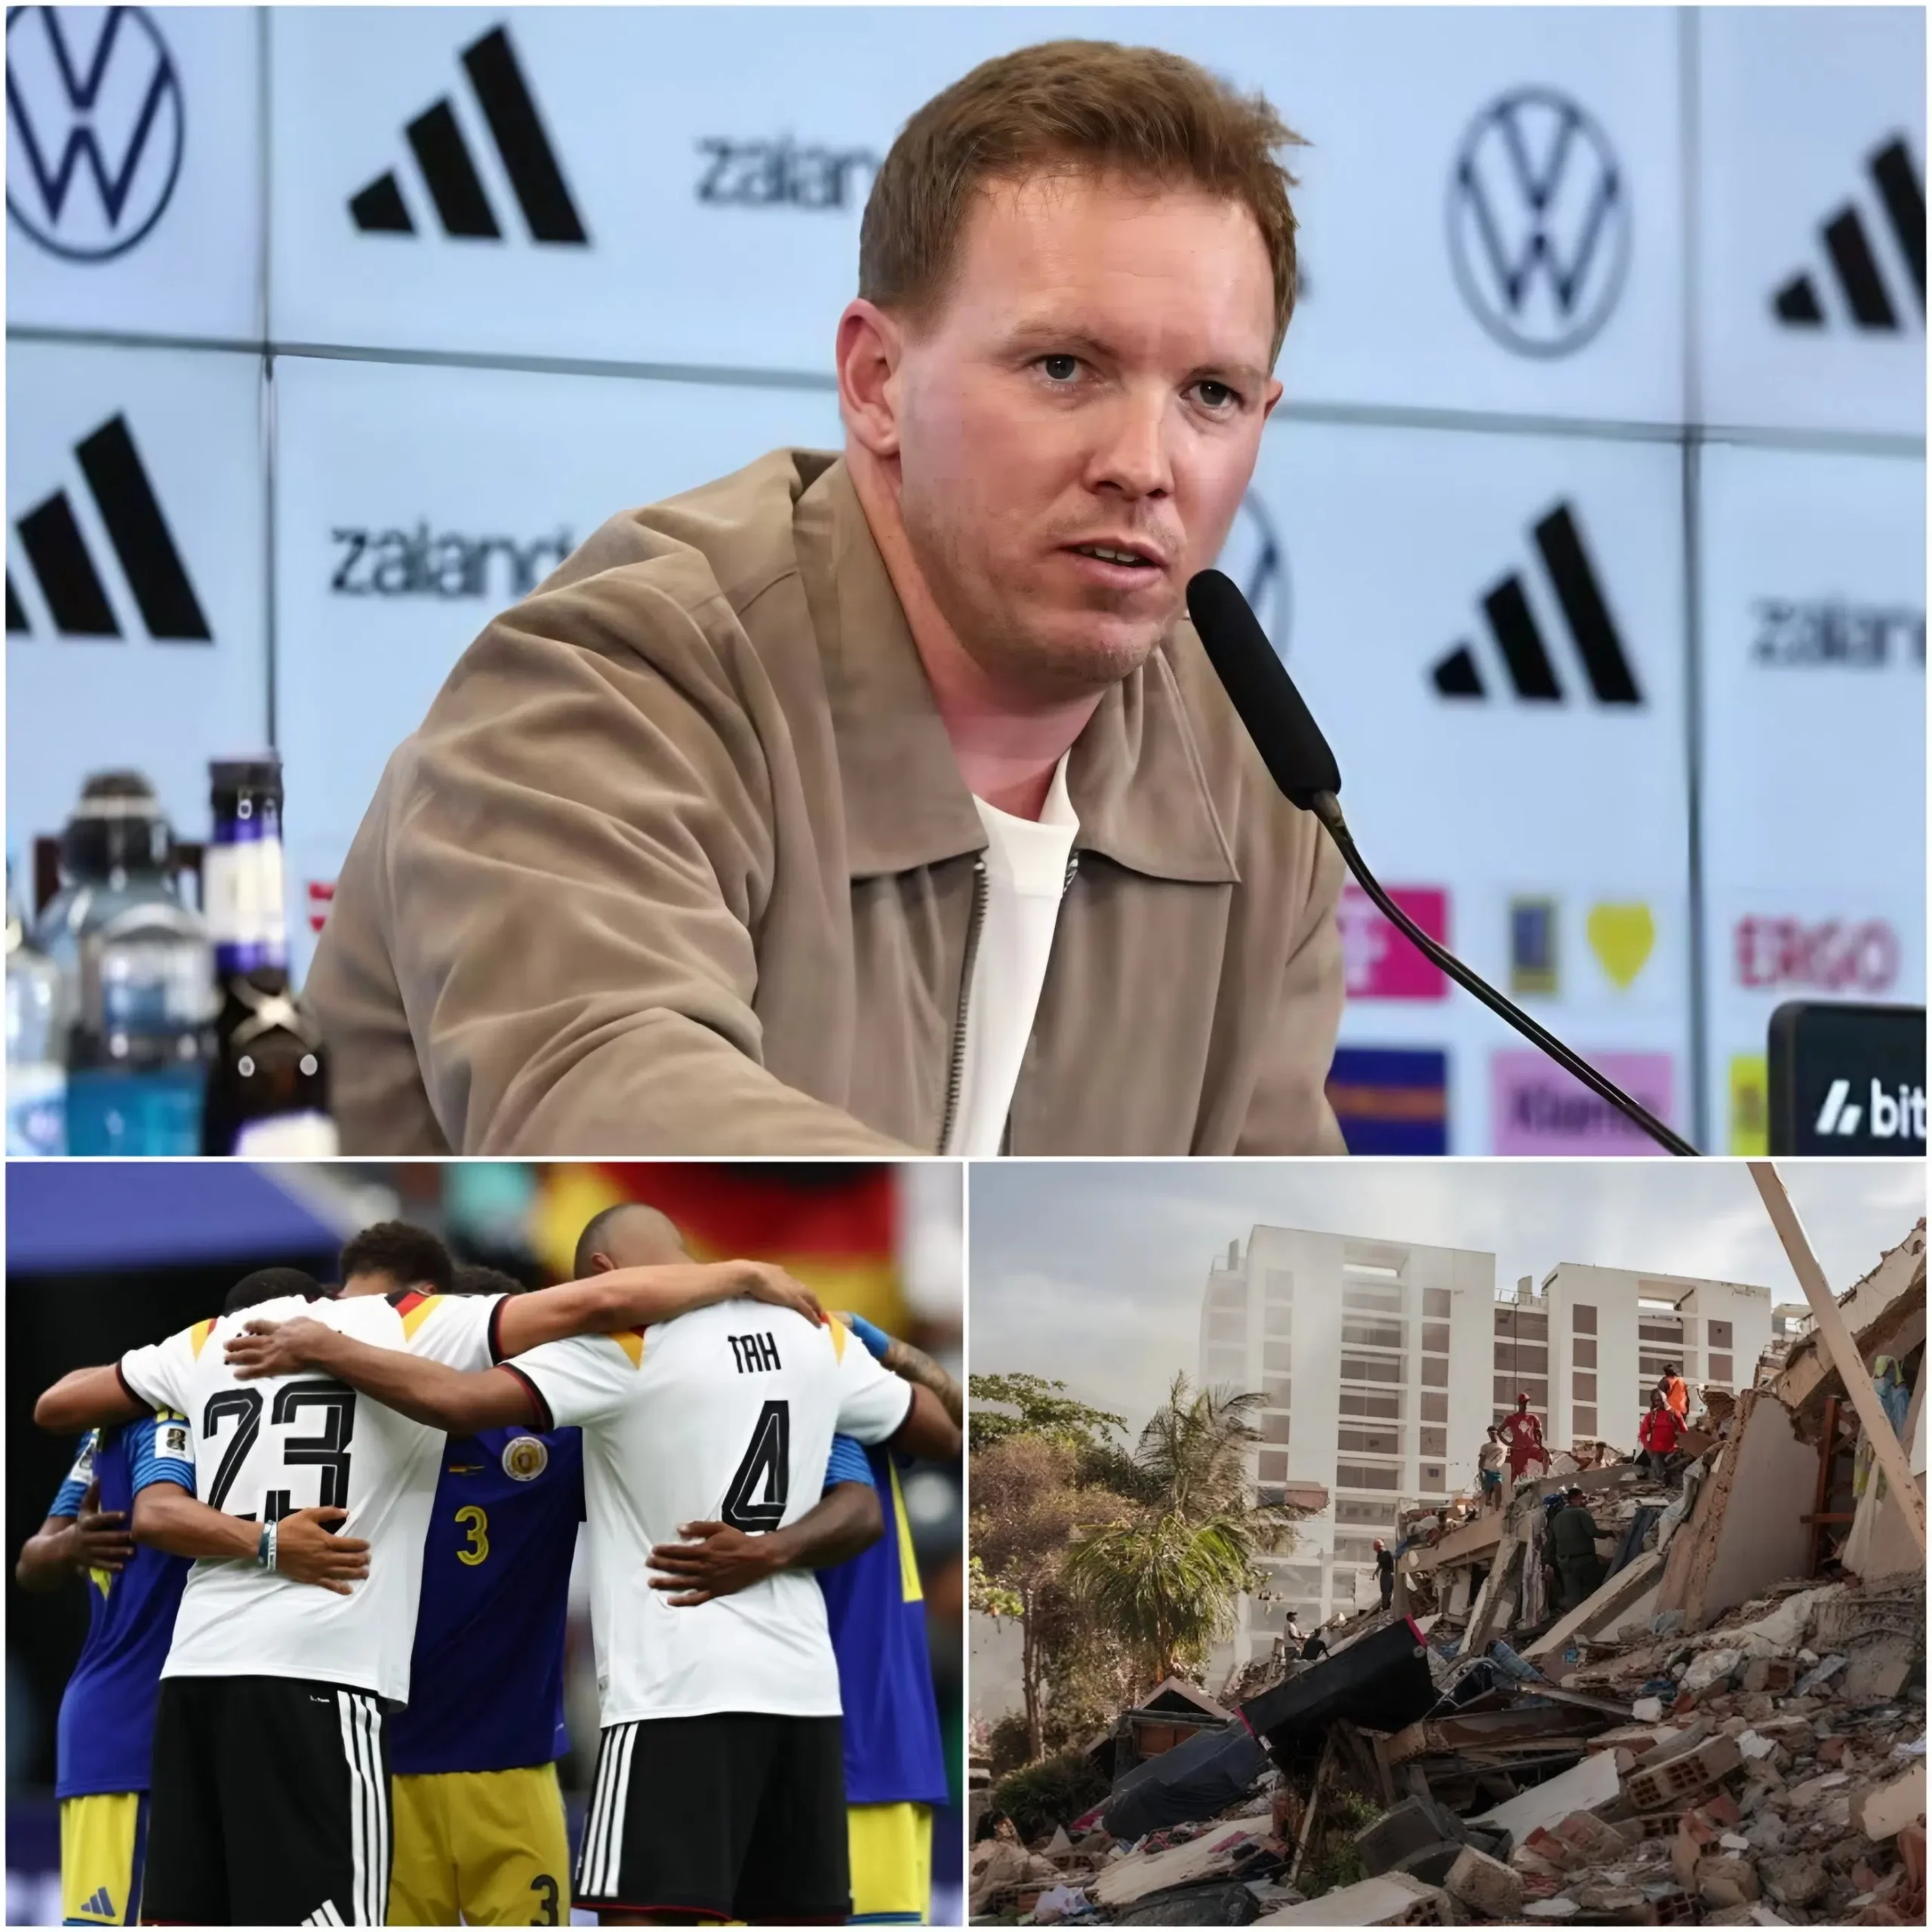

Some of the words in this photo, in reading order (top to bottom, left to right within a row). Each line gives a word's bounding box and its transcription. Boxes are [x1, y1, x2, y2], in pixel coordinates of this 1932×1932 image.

[1869, 1077, 1927, 1138] bit
[728, 1331, 782, 1374] TAH
[203, 1380, 357, 1535] 23
[721, 1400, 790, 1532] 4
[454, 1505, 489, 1566] 3
[530, 1874, 559, 1927] 3
